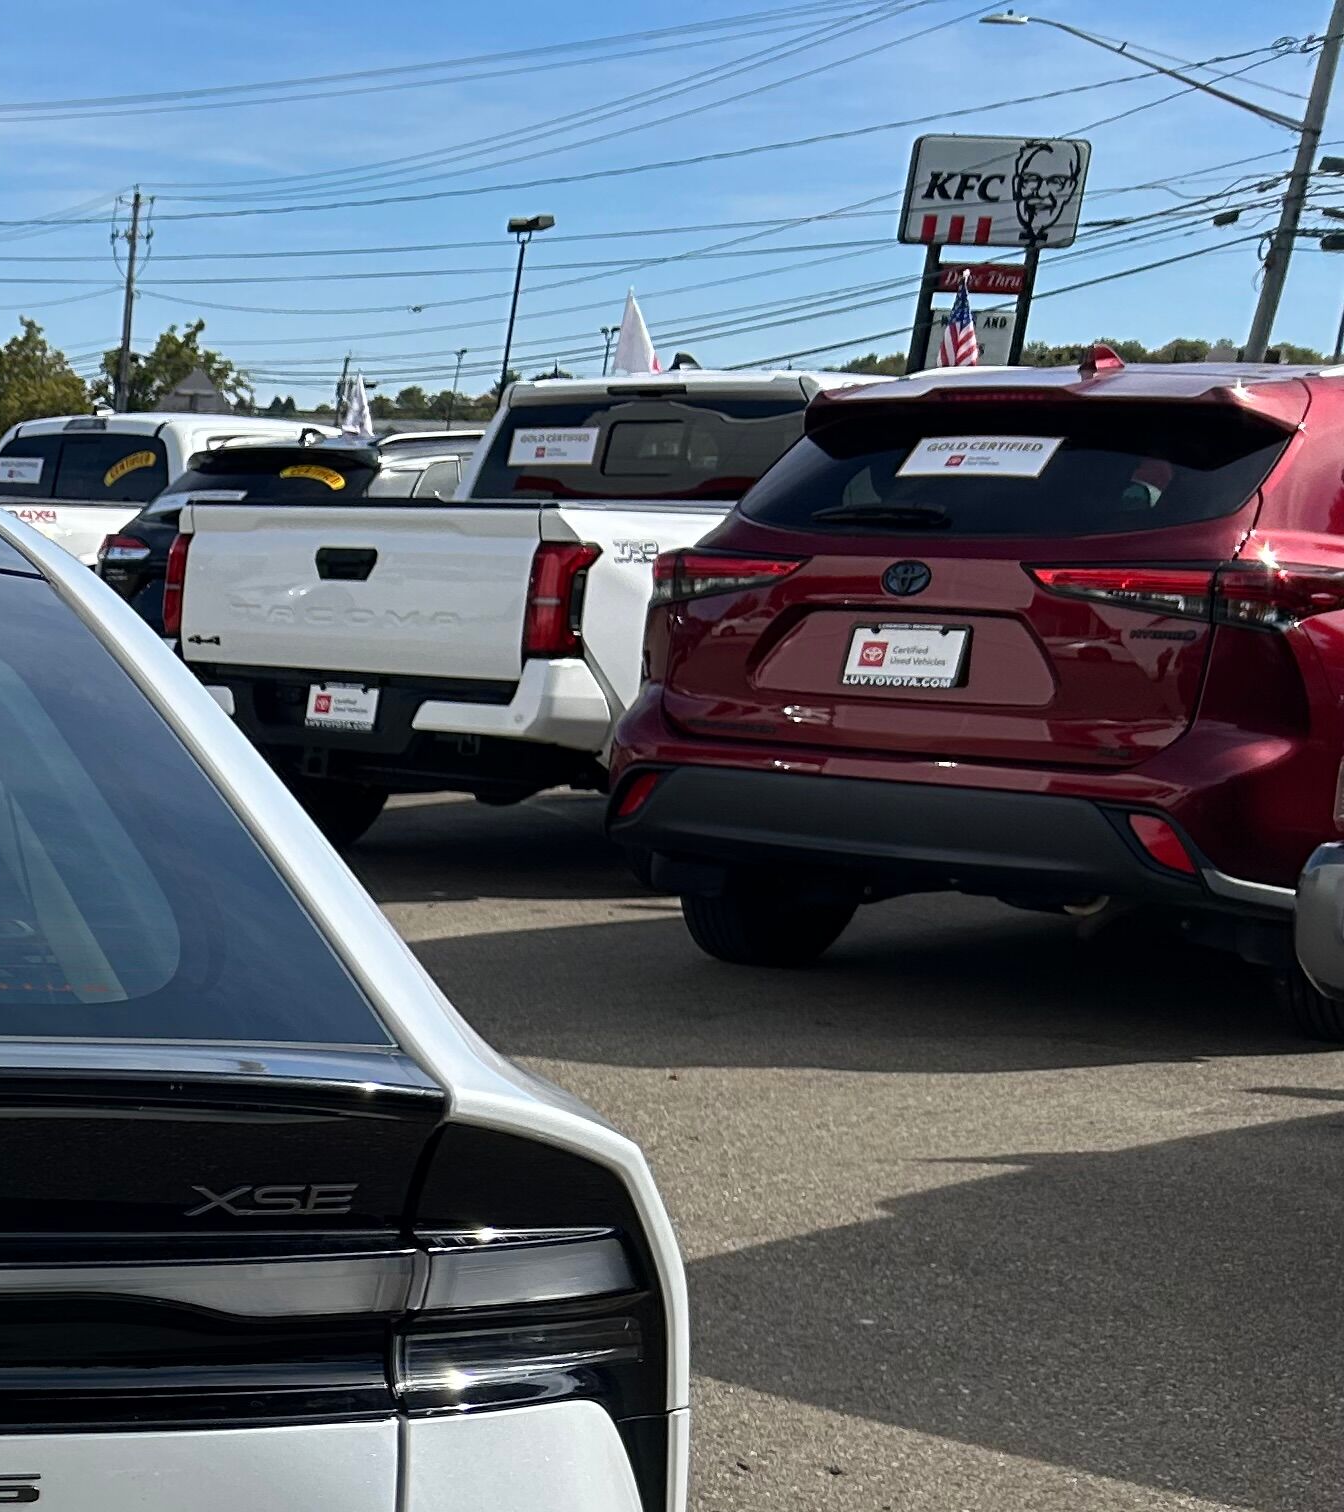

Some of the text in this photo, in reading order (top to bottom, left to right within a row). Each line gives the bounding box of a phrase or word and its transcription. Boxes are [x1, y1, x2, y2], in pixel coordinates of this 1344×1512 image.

[921, 171, 1006, 203] KFC
[987, 270, 1022, 288] Thru
[983, 316, 1007, 329] AND
[926, 441, 1044, 452] GOLD CERTIFIED
[891, 645, 929, 654] Certified
[842, 674, 951, 688] LUVTOYOTA.COM
[184, 1183, 359, 1216] XSE
